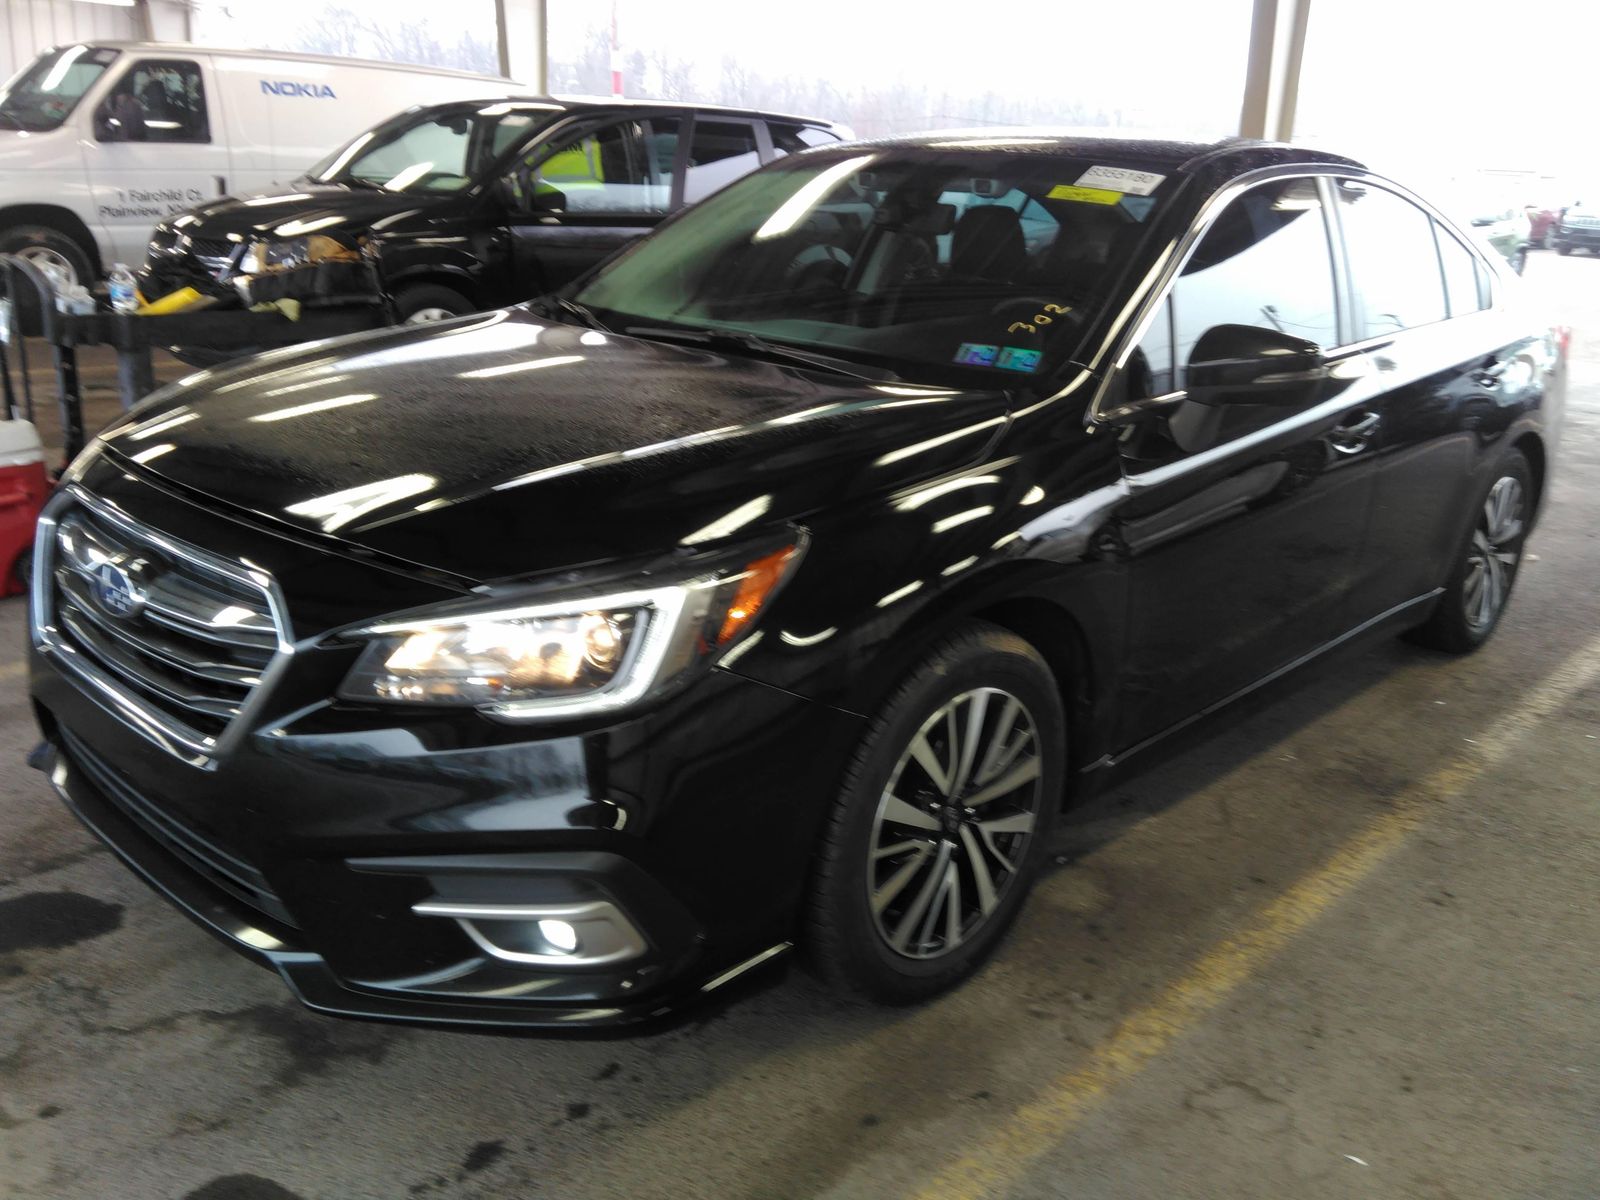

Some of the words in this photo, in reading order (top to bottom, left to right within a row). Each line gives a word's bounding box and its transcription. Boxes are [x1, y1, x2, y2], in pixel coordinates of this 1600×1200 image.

[260, 80, 337, 99] NOKIA
[128, 188, 182, 202] Fairchild
[1007, 303, 1072, 333] 302
